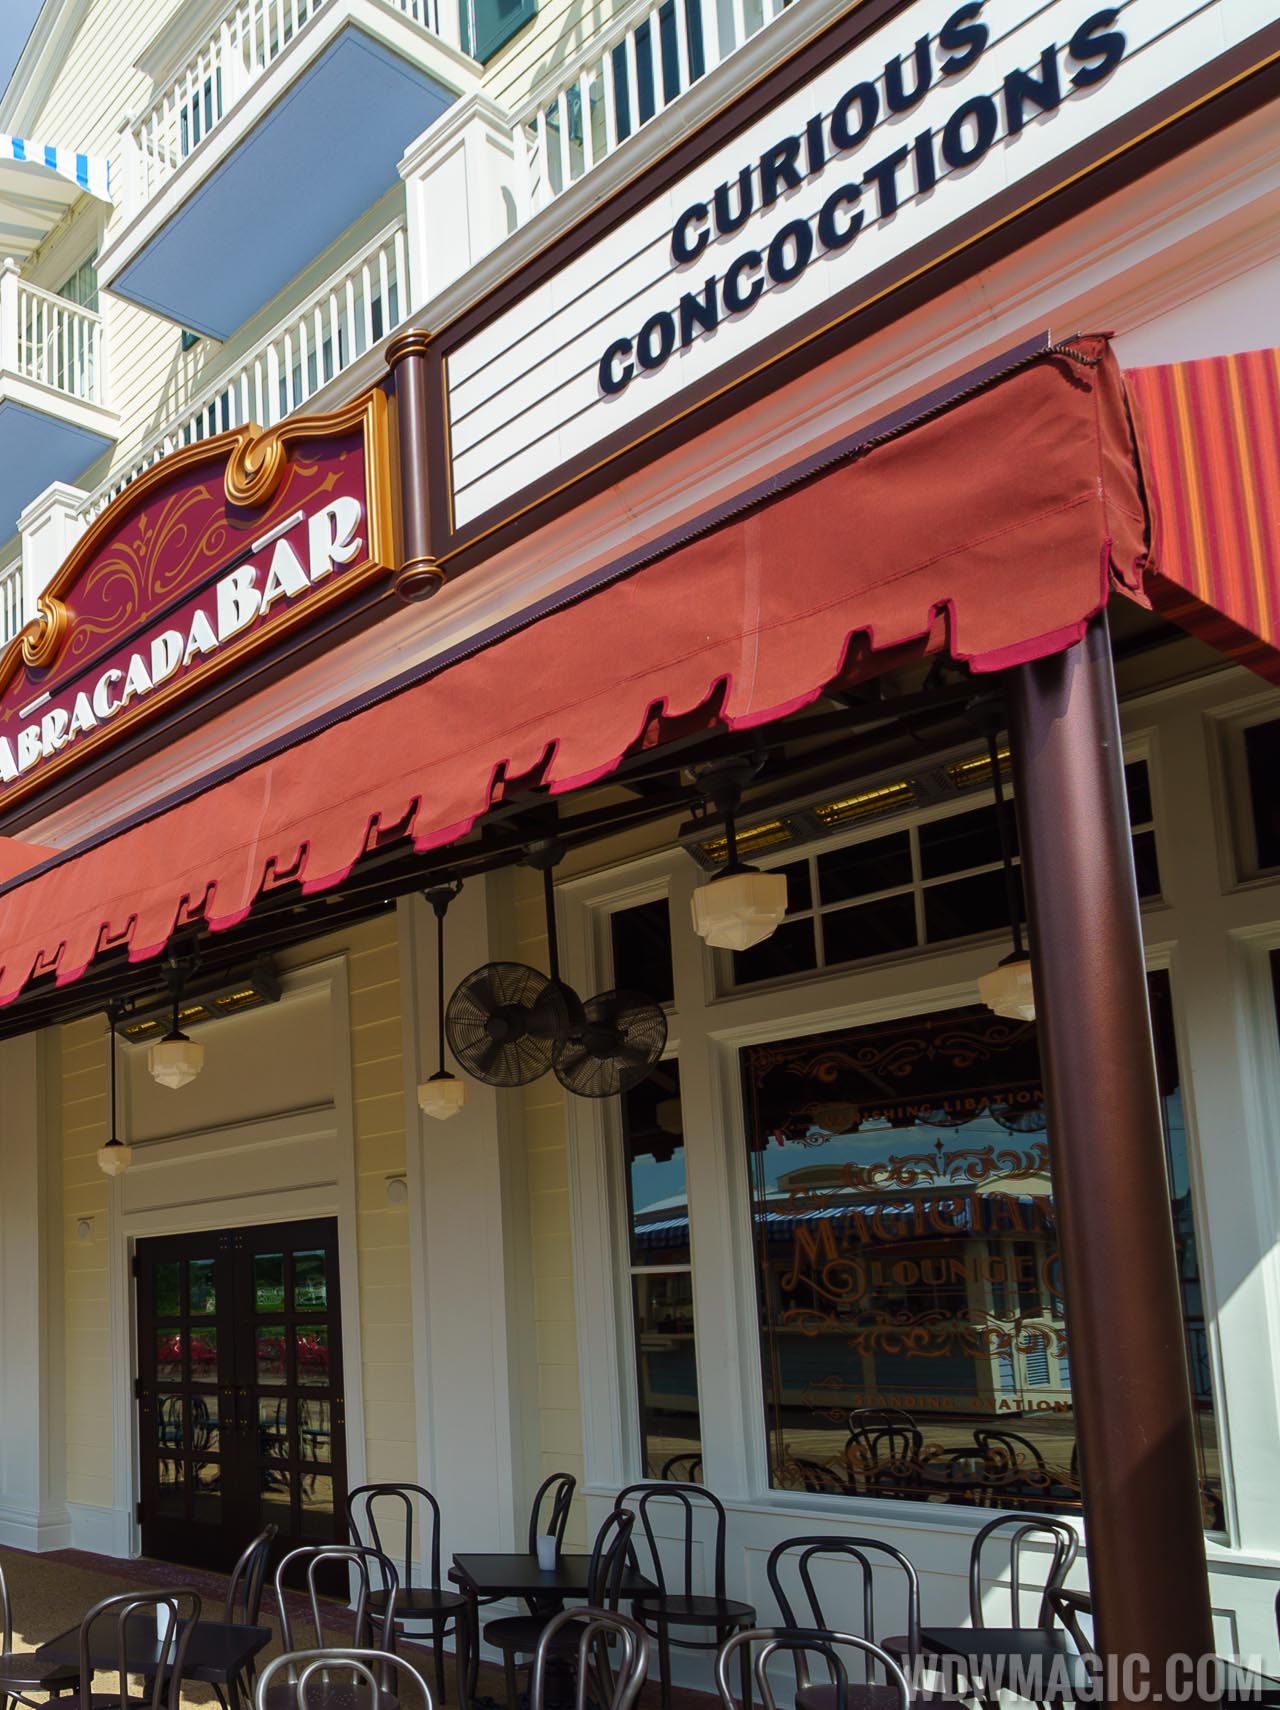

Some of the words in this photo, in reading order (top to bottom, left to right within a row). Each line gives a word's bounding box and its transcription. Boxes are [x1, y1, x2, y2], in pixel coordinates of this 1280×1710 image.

[599, 7, 1126, 395] CONCOCTIONS
[671, 1, 989, 264] CURIOUS
[872, 1256, 1035, 1286] LOUNGE
